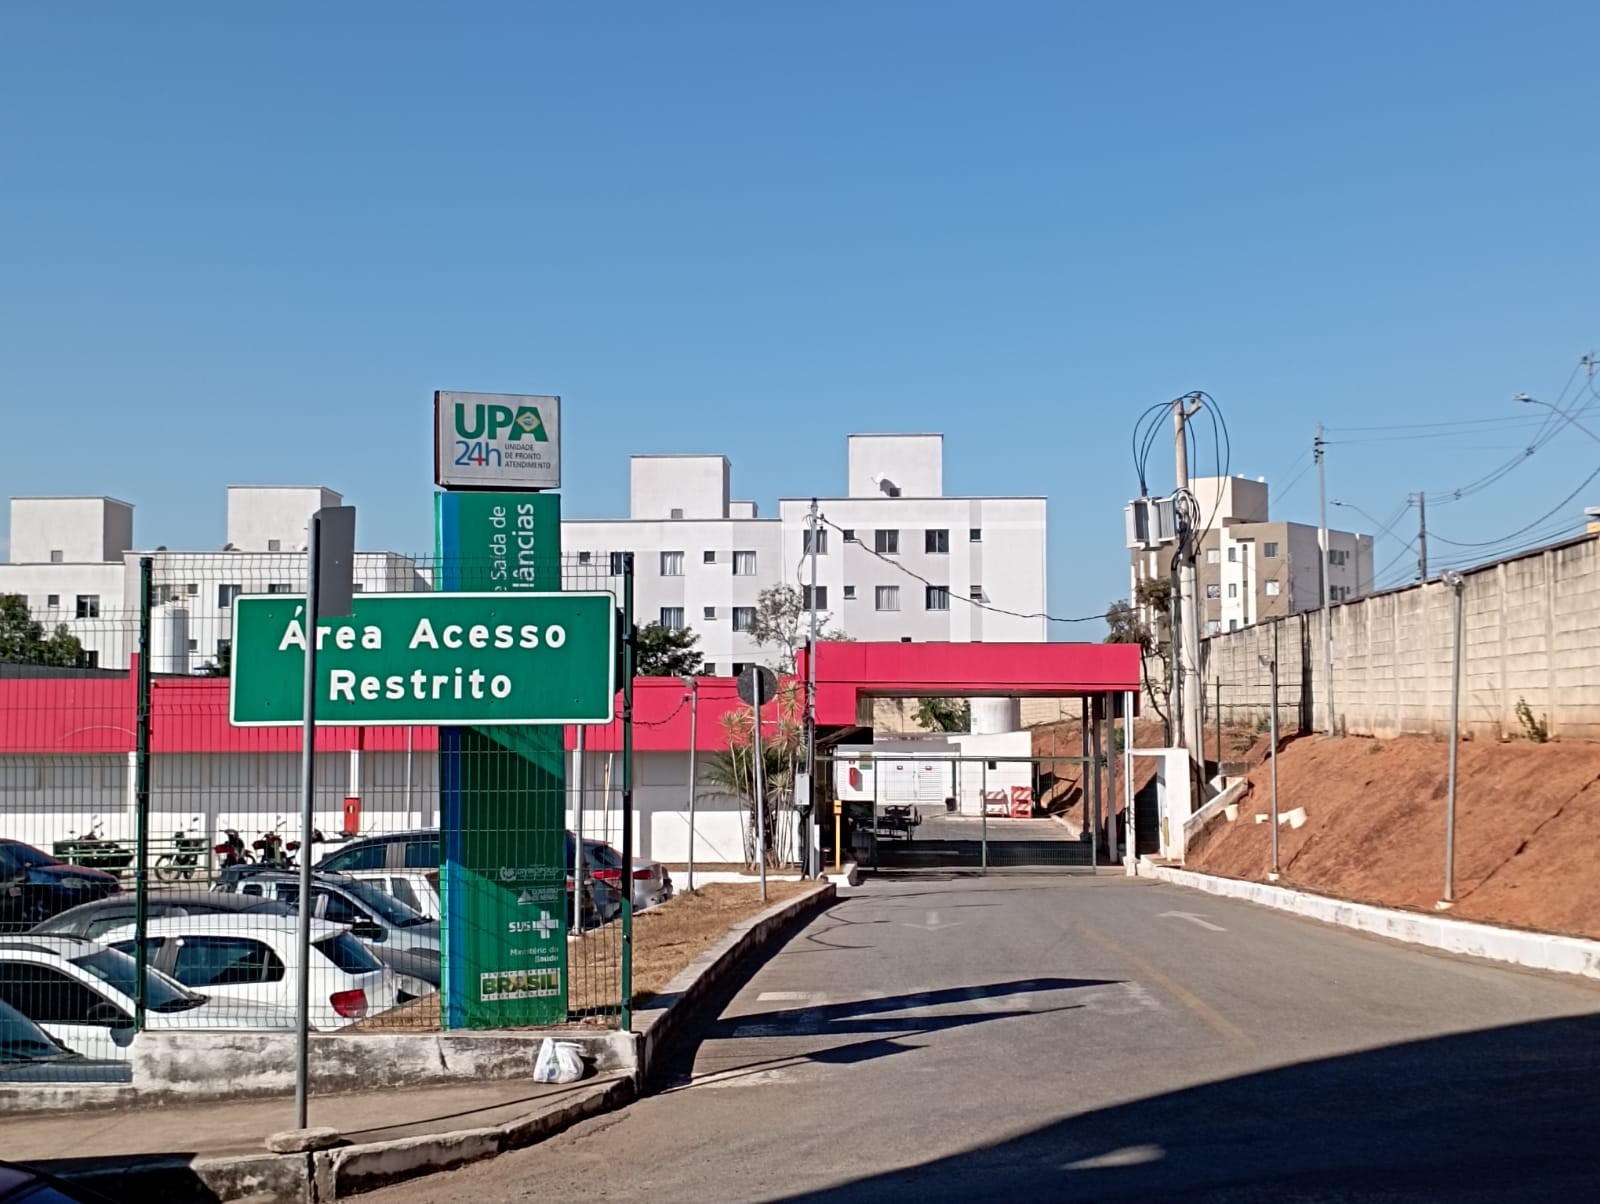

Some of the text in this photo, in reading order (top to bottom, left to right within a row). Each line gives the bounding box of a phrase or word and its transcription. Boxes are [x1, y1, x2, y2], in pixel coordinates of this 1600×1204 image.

[455, 403, 549, 442] UPA
[454, 441, 502, 467] 24h
[504, 443, 534, 451] UNIDADE
[515, 452, 541, 460] PRONTO
[488, 506, 506, 528] de
[512, 503, 535, 587] lâncias
[278, 606, 567, 650] Área Acesso
[329, 666, 513, 701] Restrito
[508, 921, 531, 933] SUS
[482, 974, 559, 995] BRASIL
